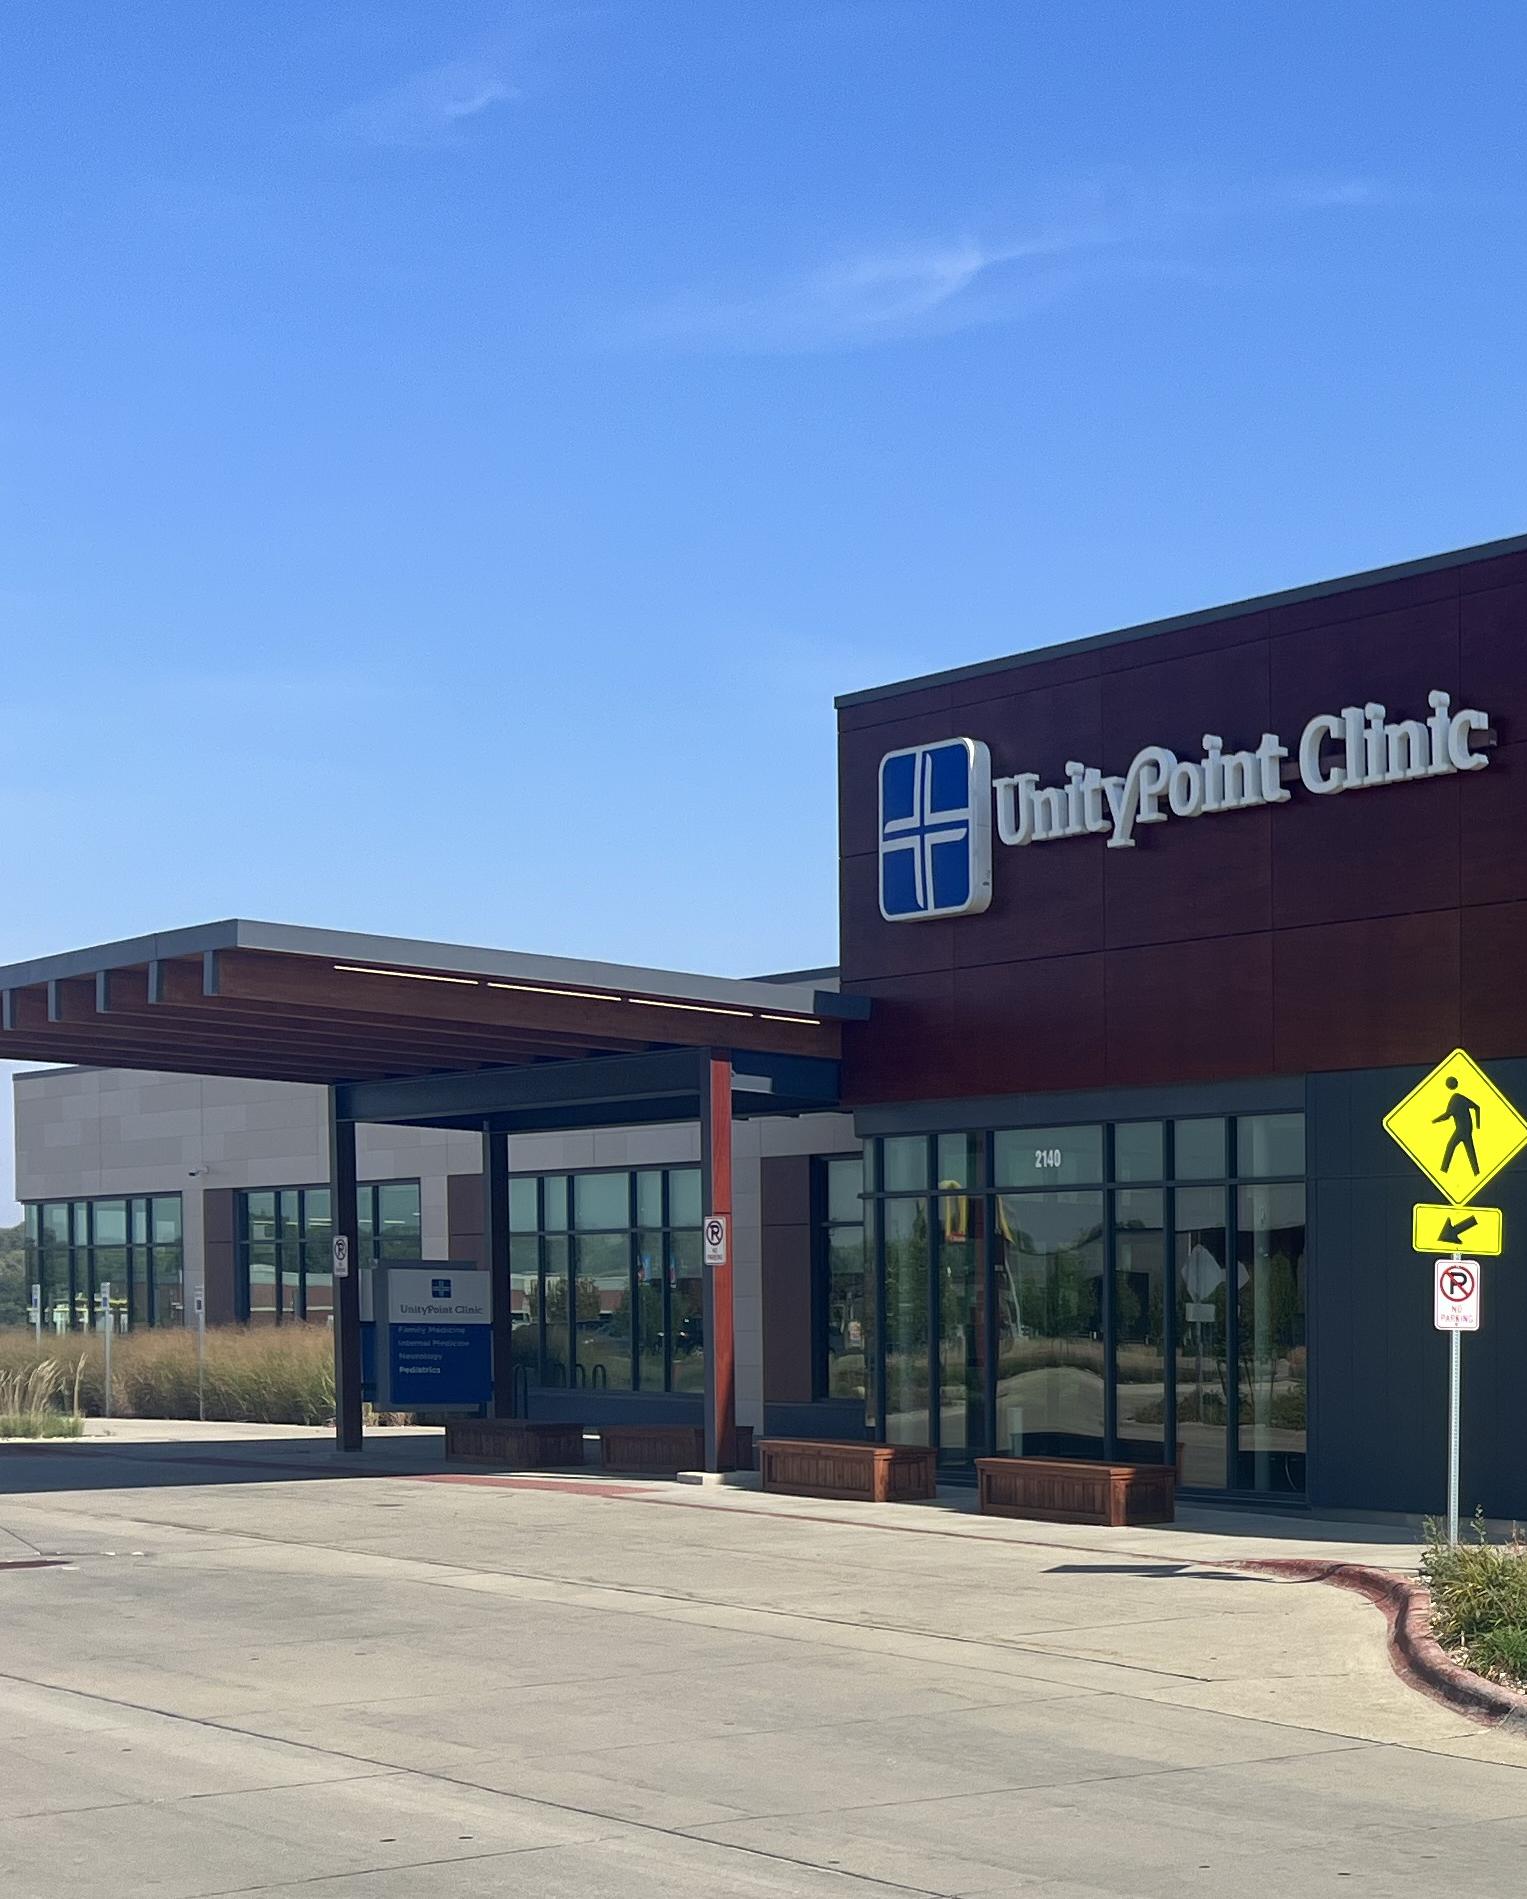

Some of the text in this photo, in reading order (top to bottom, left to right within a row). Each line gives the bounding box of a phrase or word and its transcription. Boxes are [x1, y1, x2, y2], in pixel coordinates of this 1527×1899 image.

[993, 690, 1489, 848] UnityPoint Clinic
[1035, 1149, 1061, 1168] 2140
[400, 1304, 484, 1316] UnityPoint Clinic
[1451, 1305, 1463, 1313] NO
[1440, 1314, 1474, 1323] PARKING
[399, 1366, 441, 1374] Pediatrics
